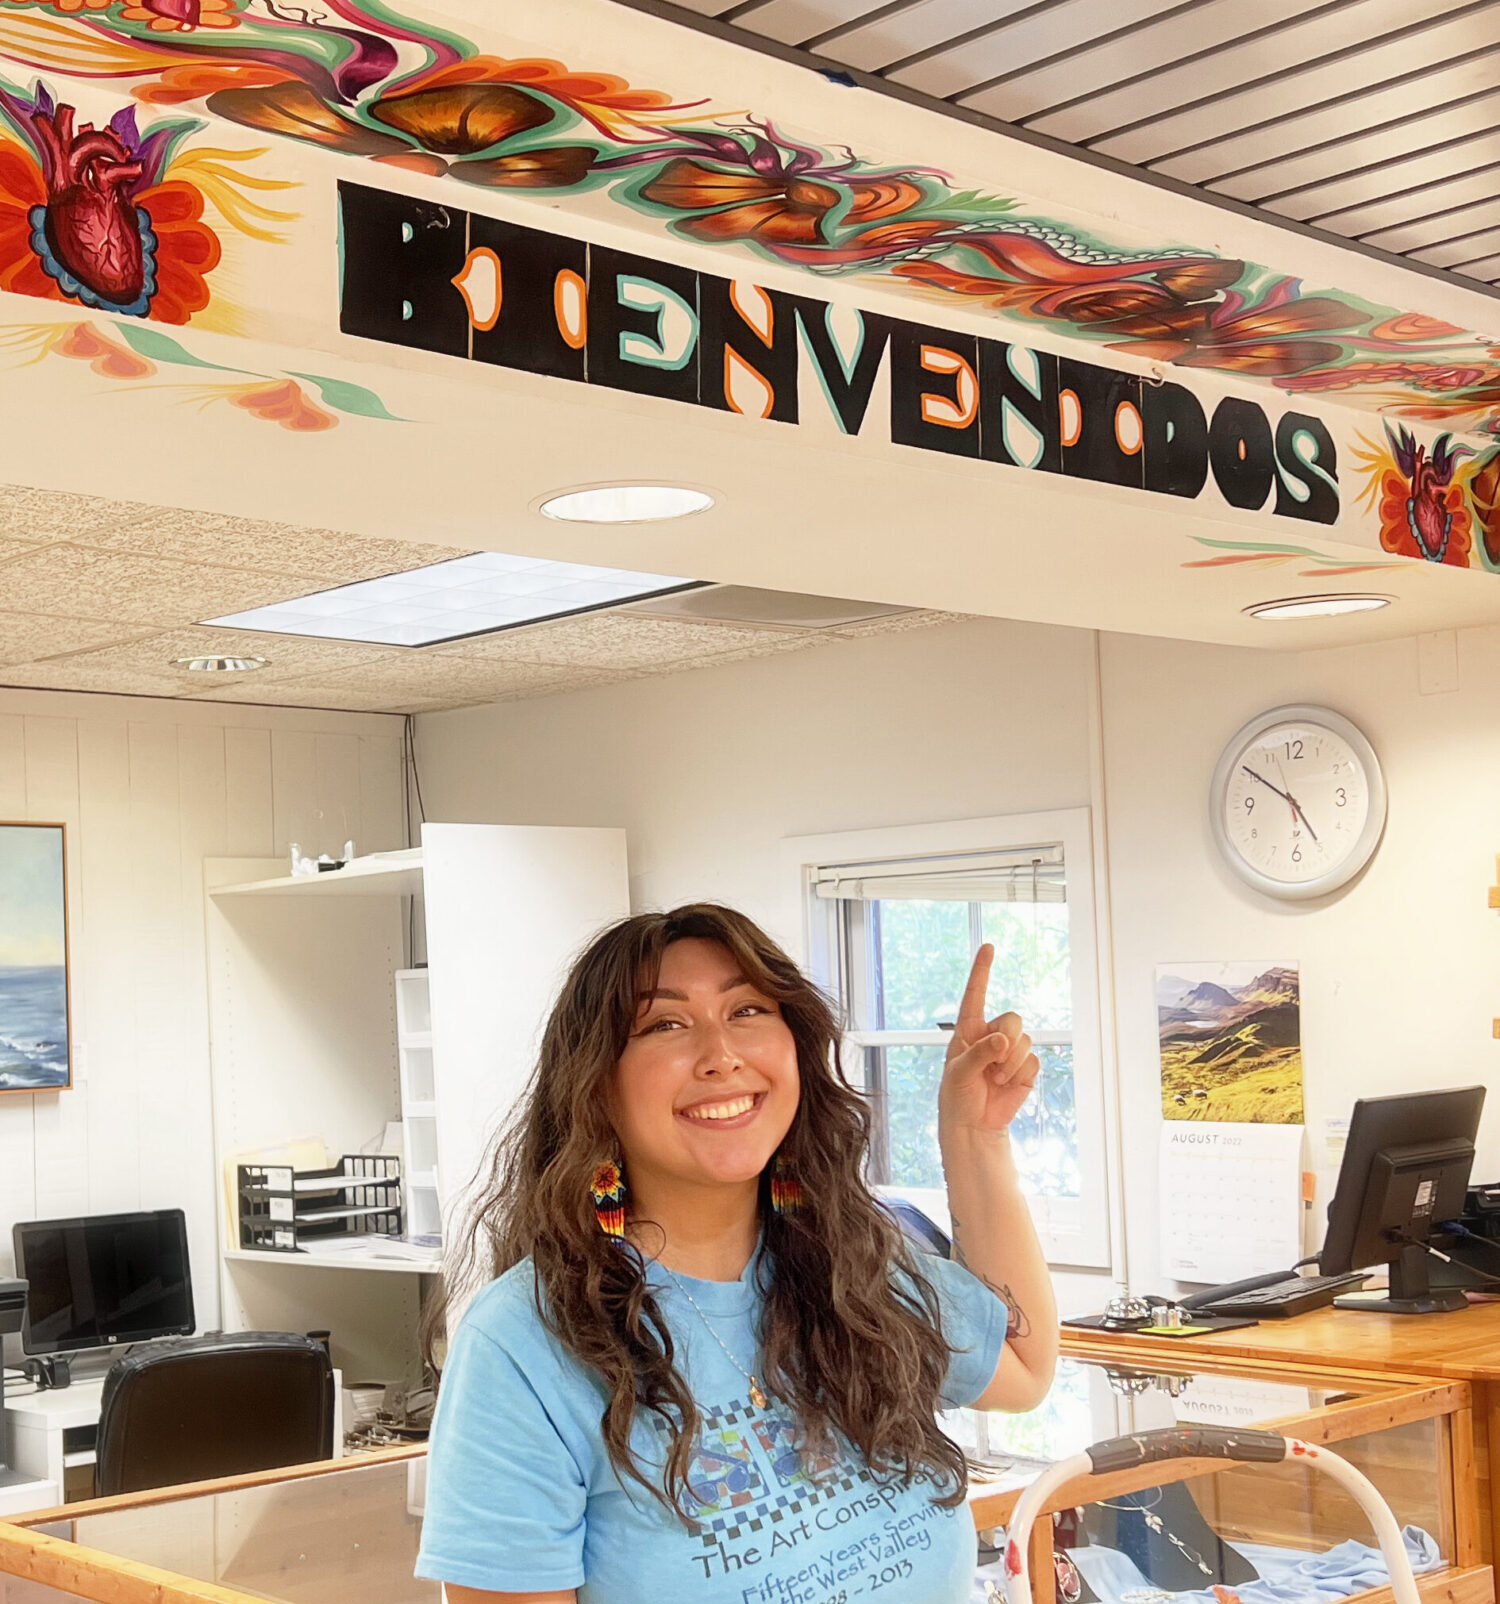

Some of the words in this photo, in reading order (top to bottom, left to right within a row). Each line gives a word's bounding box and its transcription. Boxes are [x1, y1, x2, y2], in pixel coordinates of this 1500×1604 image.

[337, 179, 1339, 526] BIENVENIDOS
[1265, 753, 1275, 764] 11
[1285, 740, 1304, 760] 12
[1315, 747, 1320, 758] 1
[1332, 764, 1340, 775] 2
[1244, 797, 1255, 816] 9
[1335, 788, 1347, 807] 3
[1251, 828, 1258, 839] 8
[1271, 846, 1277, 857] 7
[1292, 843, 1302, 862] 6
[1171, 1134, 1220, 1145] AUGUST
[1222, 1136, 1242, 1146] 2022
[691, 1541, 762, 1579] The
[770, 1520, 813, 1558] Art
[815, 1473, 928, 1531] Conspira
[741, 1562, 820, 1604] Fifteen
[819, 1531, 881, 1567] Years
[883, 1502, 956, 1536] Serving
[816, 1555, 867, 1590] West
[868, 1528, 932, 1563] Valley
[867, 1558, 914, 1591] 2013
